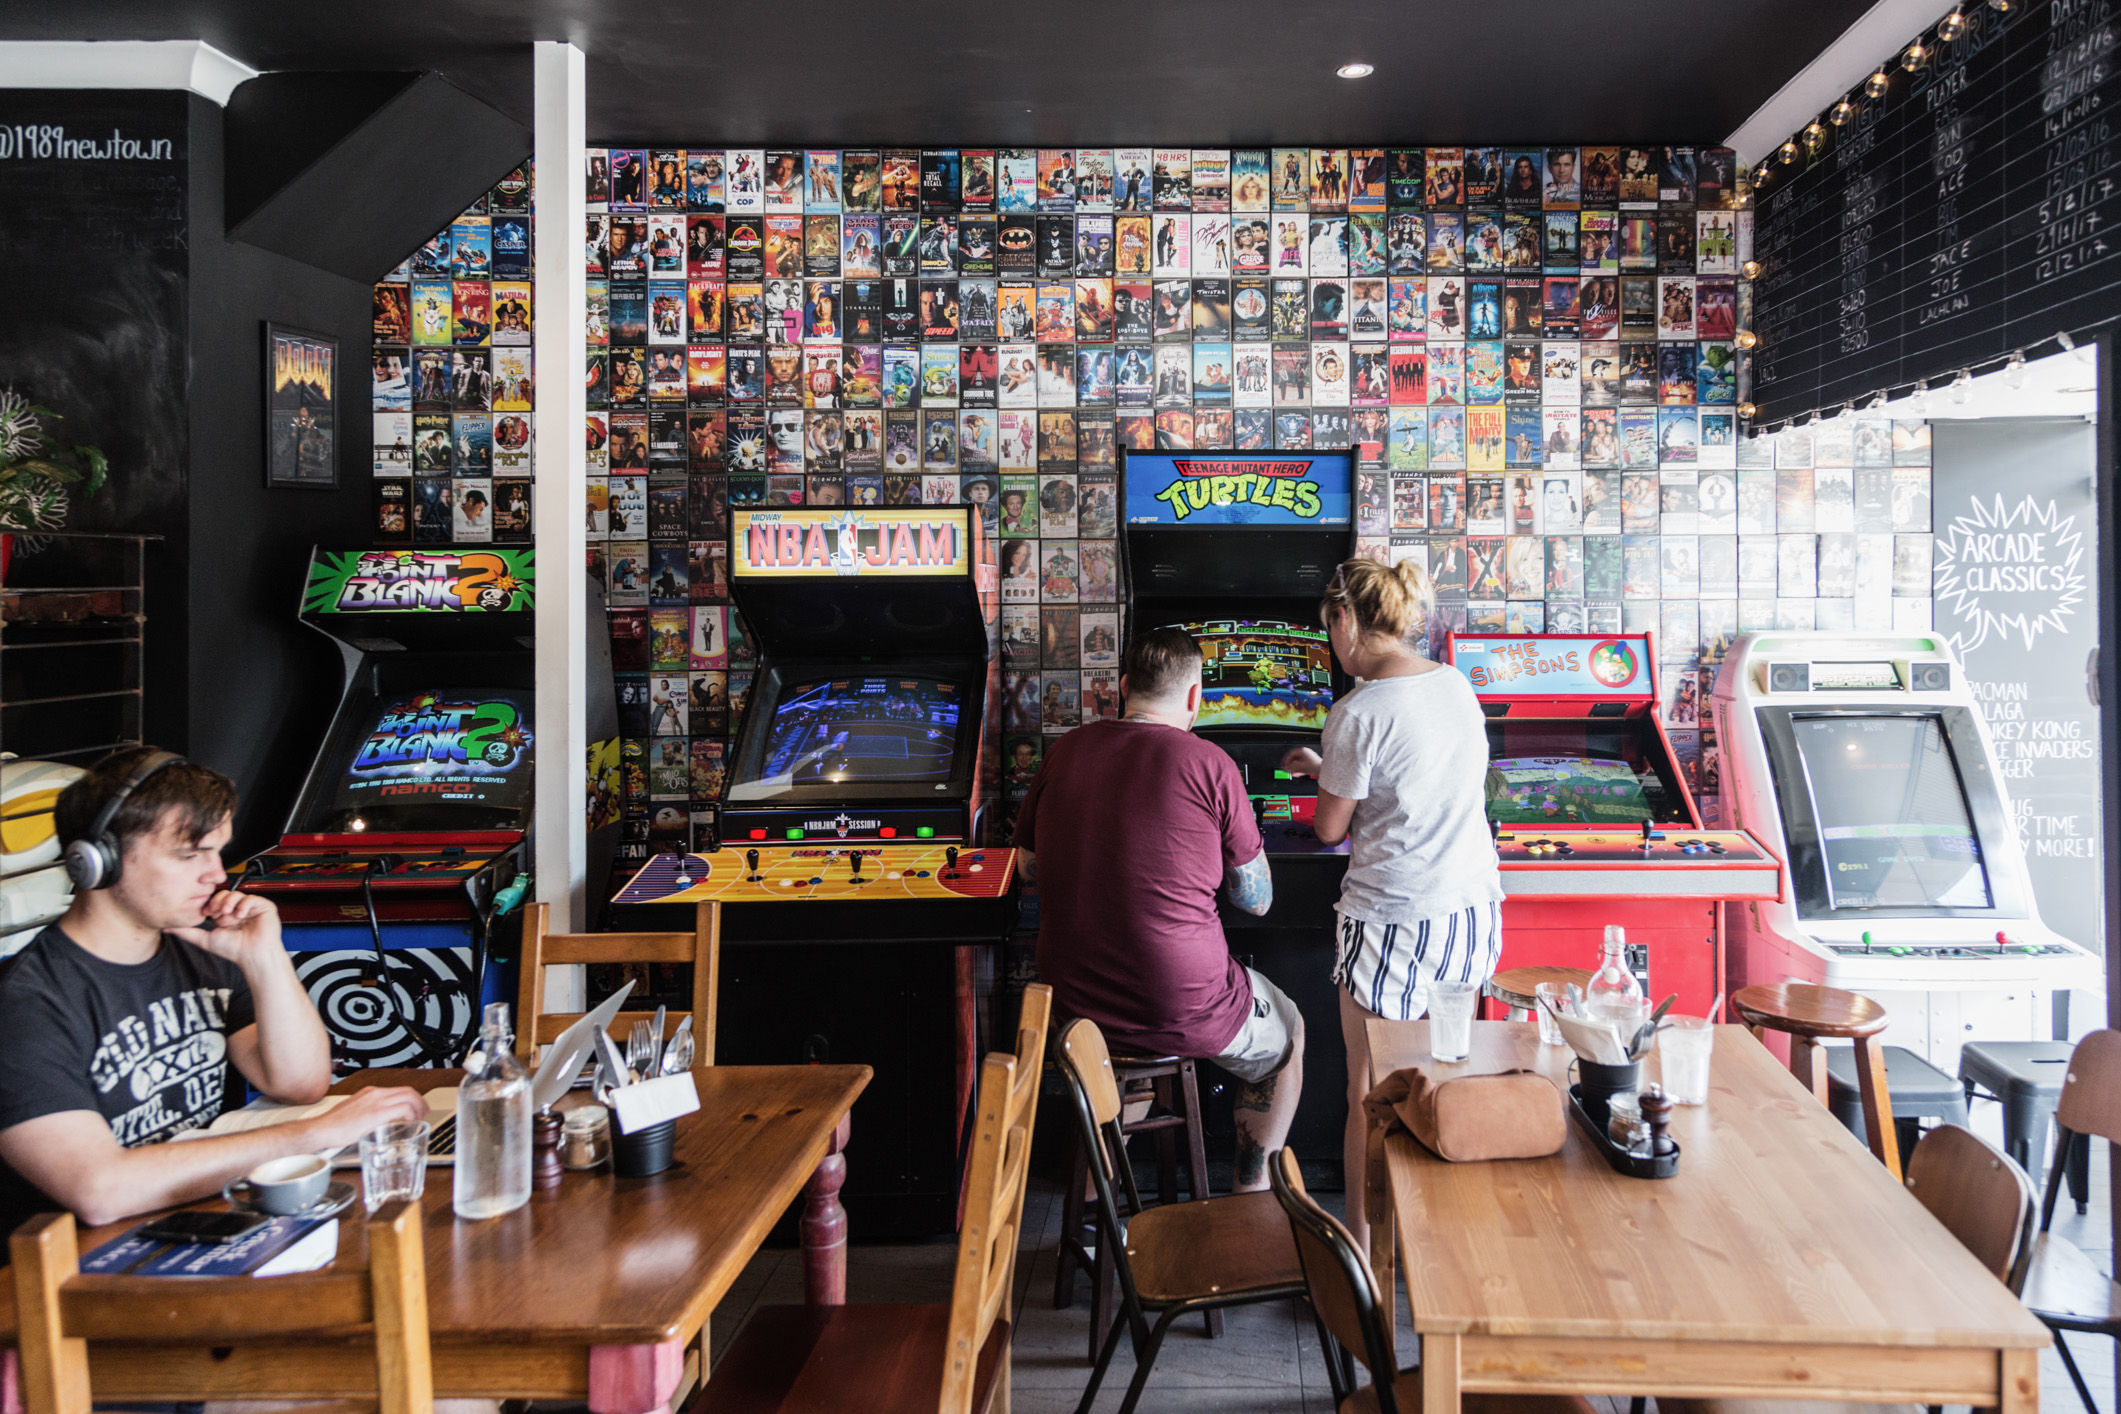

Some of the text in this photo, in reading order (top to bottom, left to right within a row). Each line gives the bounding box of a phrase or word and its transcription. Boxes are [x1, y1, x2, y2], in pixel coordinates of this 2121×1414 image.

[1927, 66, 1967, 112] PLAYER
[809, 154, 837, 165] TWINS
[1079, 158, 1105, 169] Trading
[1157, 153, 1169, 162] 48
[1089, 167, 1113, 175] Places
[1939, 164, 1968, 198] ACE
[736, 198, 754, 206] COP
[1505, 197, 1539, 205] BRAVEHEART
[1545, 215, 1578, 224] PRINCESS
[892, 223, 916, 231] JEDI
[495, 240, 527, 249] CASPER
[1238, 254, 1265, 266] GREASE
[1930, 241, 1972, 274] JACE
[963, 263, 993, 271] GREMLINS
[1931, 270, 1963, 298] JOE
[495, 292, 527, 301] MATILDA
[728, 287, 763, 295] PULP FICTION
[813, 321, 834, 336] big
[961, 319, 995, 327] MATRIX
[924, 327, 956, 336] SPEED
[275, 338, 331, 400] DOOM
[1469, 413, 1503, 427] THE FULL
[1511, 415, 1535, 424] Shine
[462, 423, 485, 433] FLIPPER
[1468, 427, 1503, 442] MONTY
[598, 456, 606, 468] 3
[1180, 463, 1304, 474] TEENAGE MUTANT HERO
[1155, 474, 1322, 520] TURTLES
[750, 513, 783, 522] MIDWAY
[750, 522, 955, 567] NBA JAM
[1961, 533, 2046, 564] ARCADE
[357, 551, 462, 582] POINT
[337, 553, 506, 610] BLANK 2
[1966, 565, 2067, 592] CLASSICS
[1238, 626, 1264, 634] INSERT
[1289, 630, 1313, 639] INSERT
[1491, 642, 1540, 662] THE
[1471, 652, 1580, 687] SIMPSONS
[1984, 702, 2025, 721] LAGA
[379, 704, 477, 738] POINT
[354, 702, 516, 771] BLANK 2
[2032, 721, 2081, 740] KONG
[1670, 734, 1693, 743] FLIPPER
[2016, 740, 2093, 760] INVADERS
[472, 777, 507, 785] RESERVED
[380, 783, 472, 797] namco
[1507, 785, 1627, 796] GAME OVER
[849, 819, 876, 830] SESSION
[2033, 815, 2081, 836] TIME
[790, 849, 828, 857] NBA
[2037, 838, 2095, 858] MORE!
[90, 1015, 150, 1094] OLD
[149, 987, 233, 1047] NAVY
